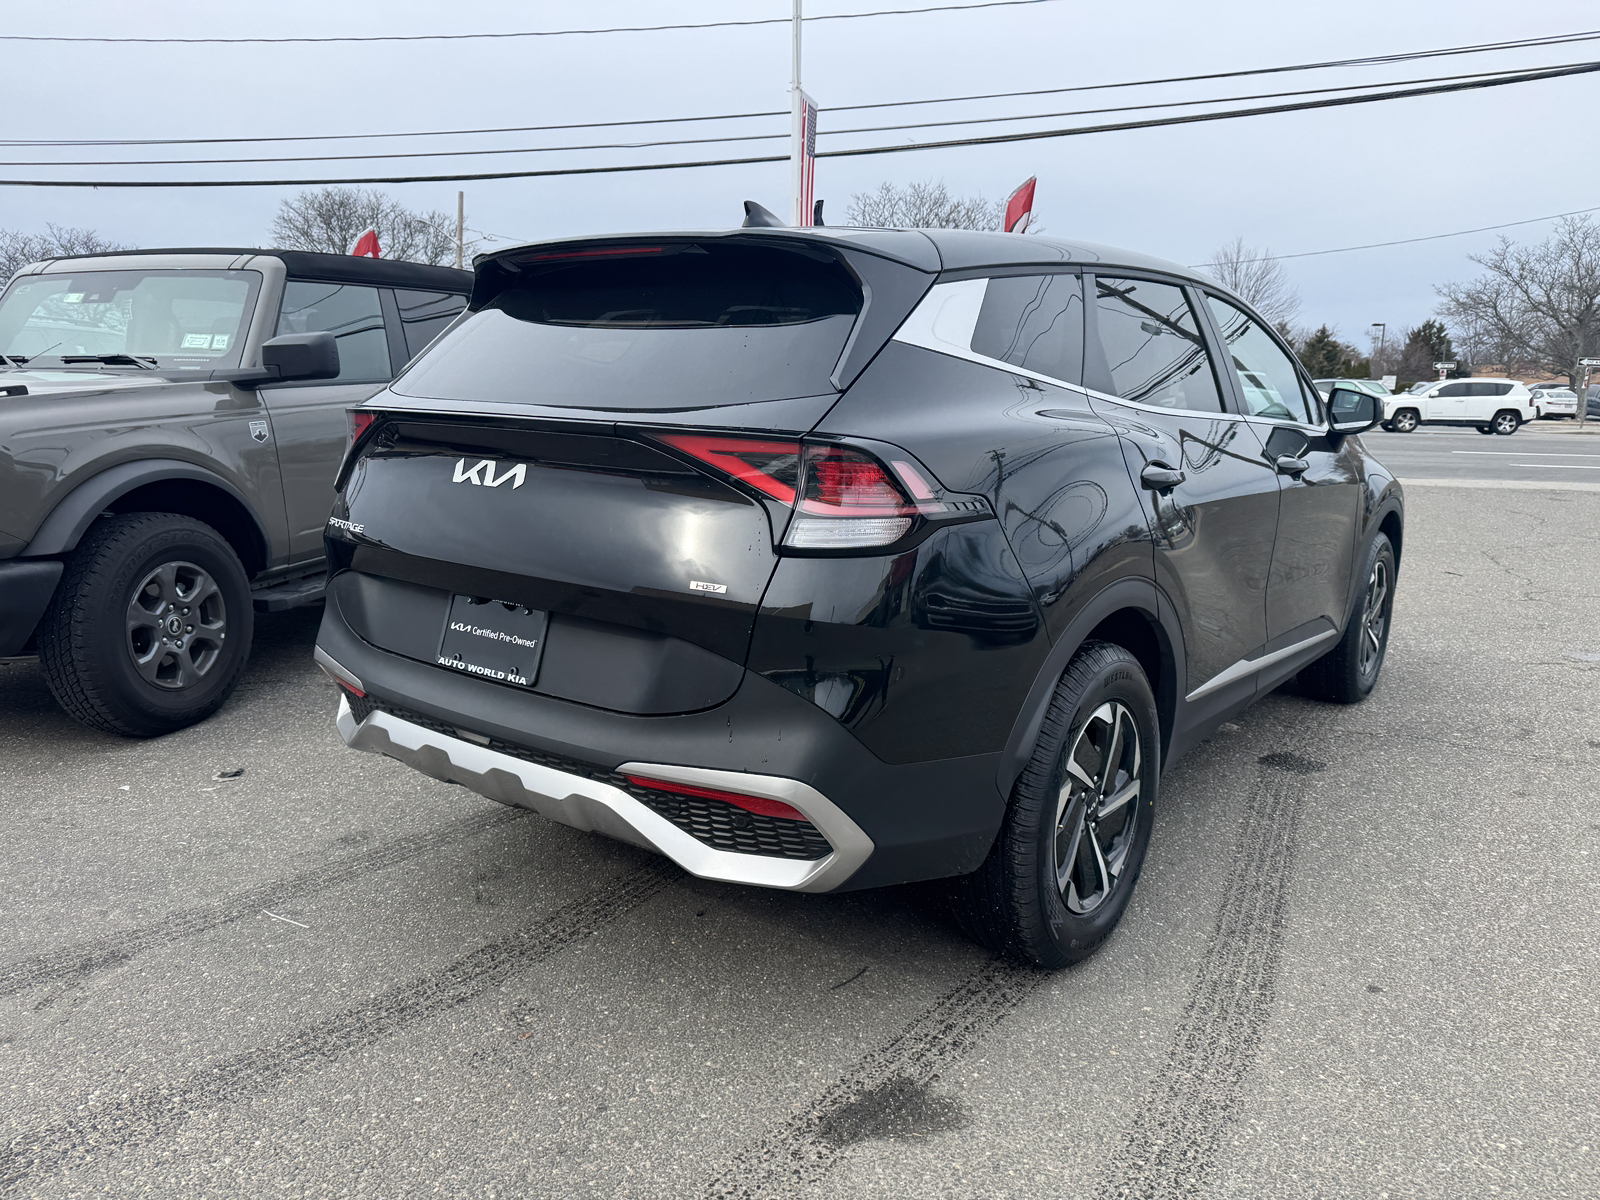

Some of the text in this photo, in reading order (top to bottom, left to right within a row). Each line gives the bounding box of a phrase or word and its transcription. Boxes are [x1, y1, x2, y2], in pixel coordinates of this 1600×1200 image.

[452, 457, 527, 490] KIA
[328, 516, 365, 533] SPORTAGE
[694, 582, 724, 592] HEV
[450, 621, 472, 633] KIA
[472, 626, 499, 640] Certified
[437, 656, 527, 686] AUTO WORLD KIA
